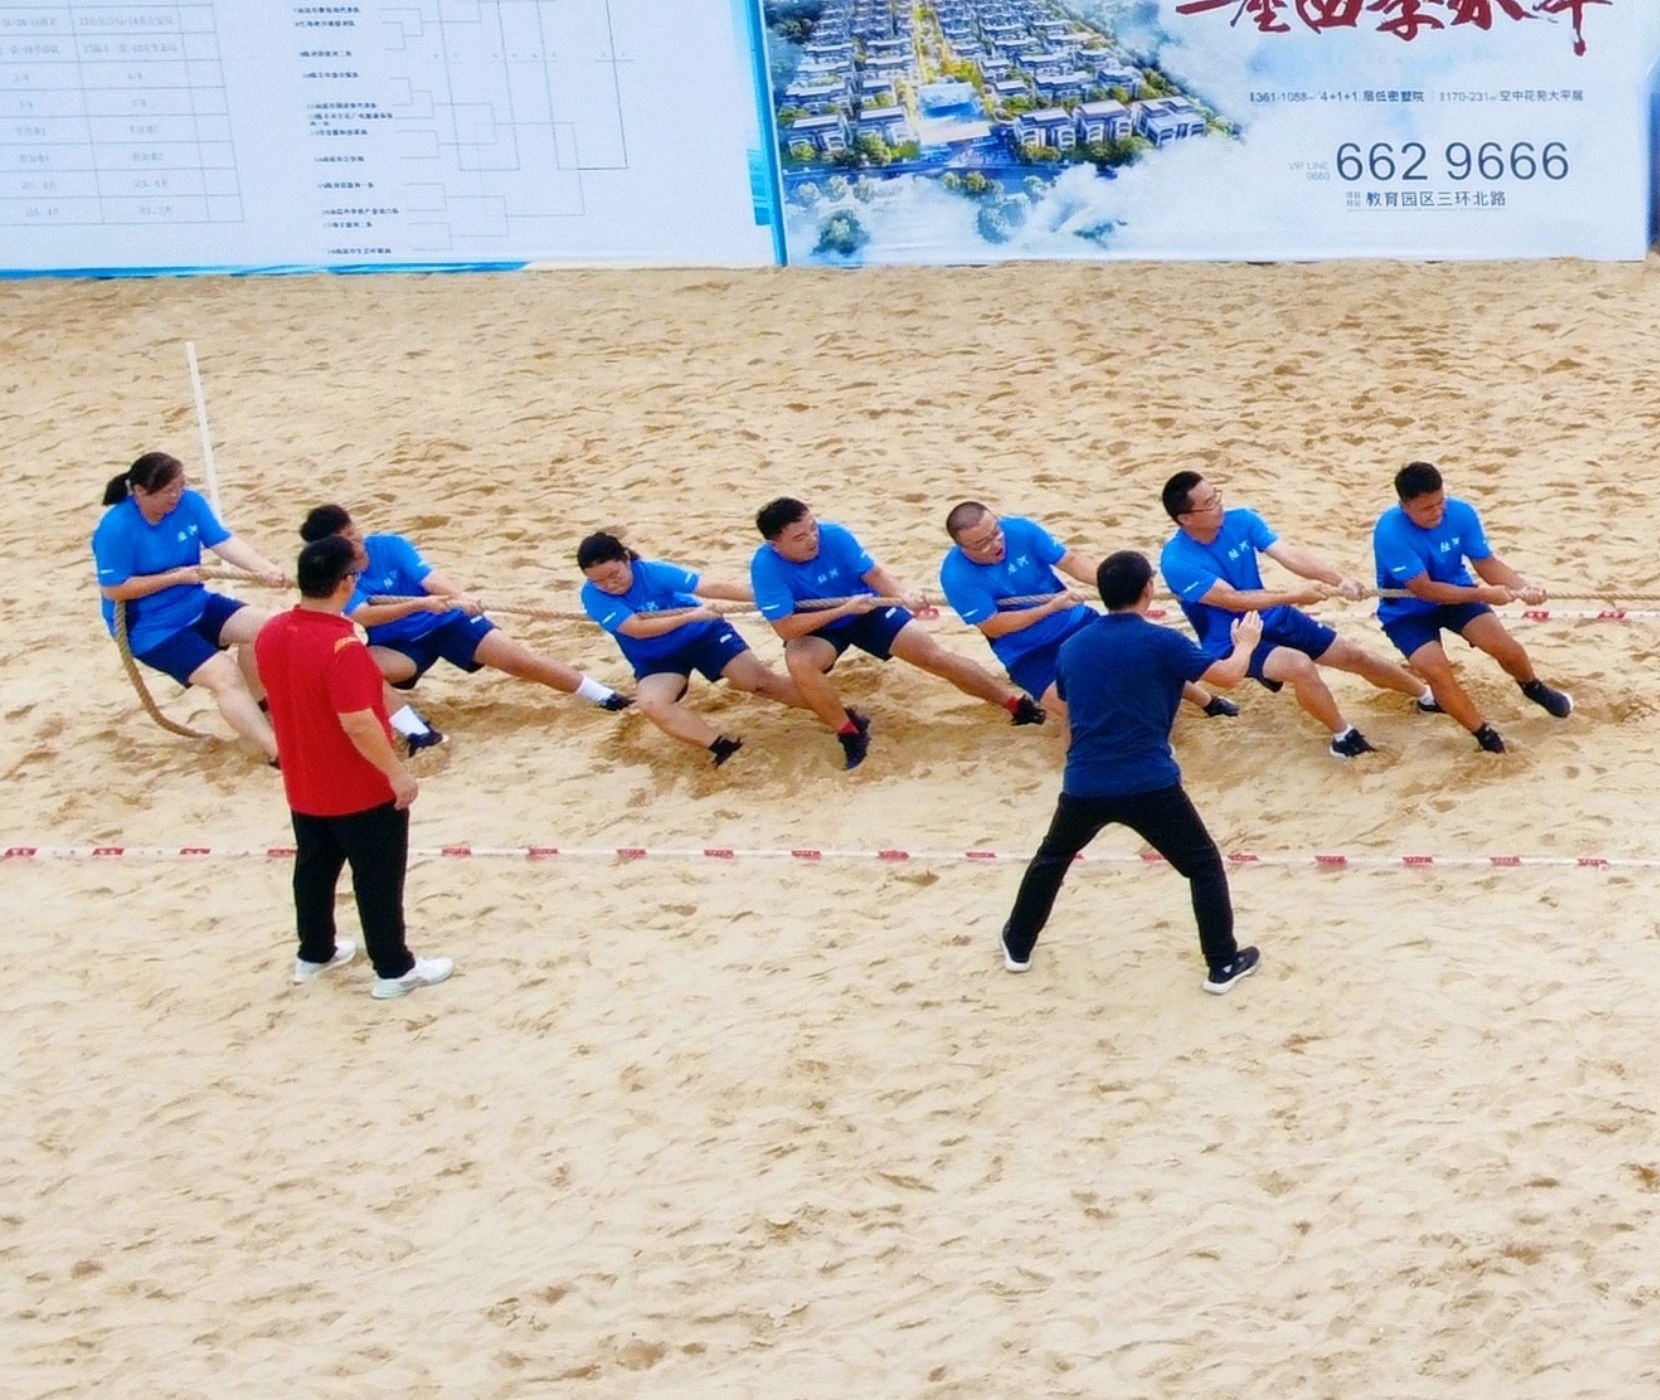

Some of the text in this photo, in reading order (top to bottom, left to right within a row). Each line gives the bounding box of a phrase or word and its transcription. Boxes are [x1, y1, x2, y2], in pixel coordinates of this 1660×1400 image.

[1336, 141, 1569, 181] 662 9666
[1365, 191, 1506, 207] 教育园区三环北路
